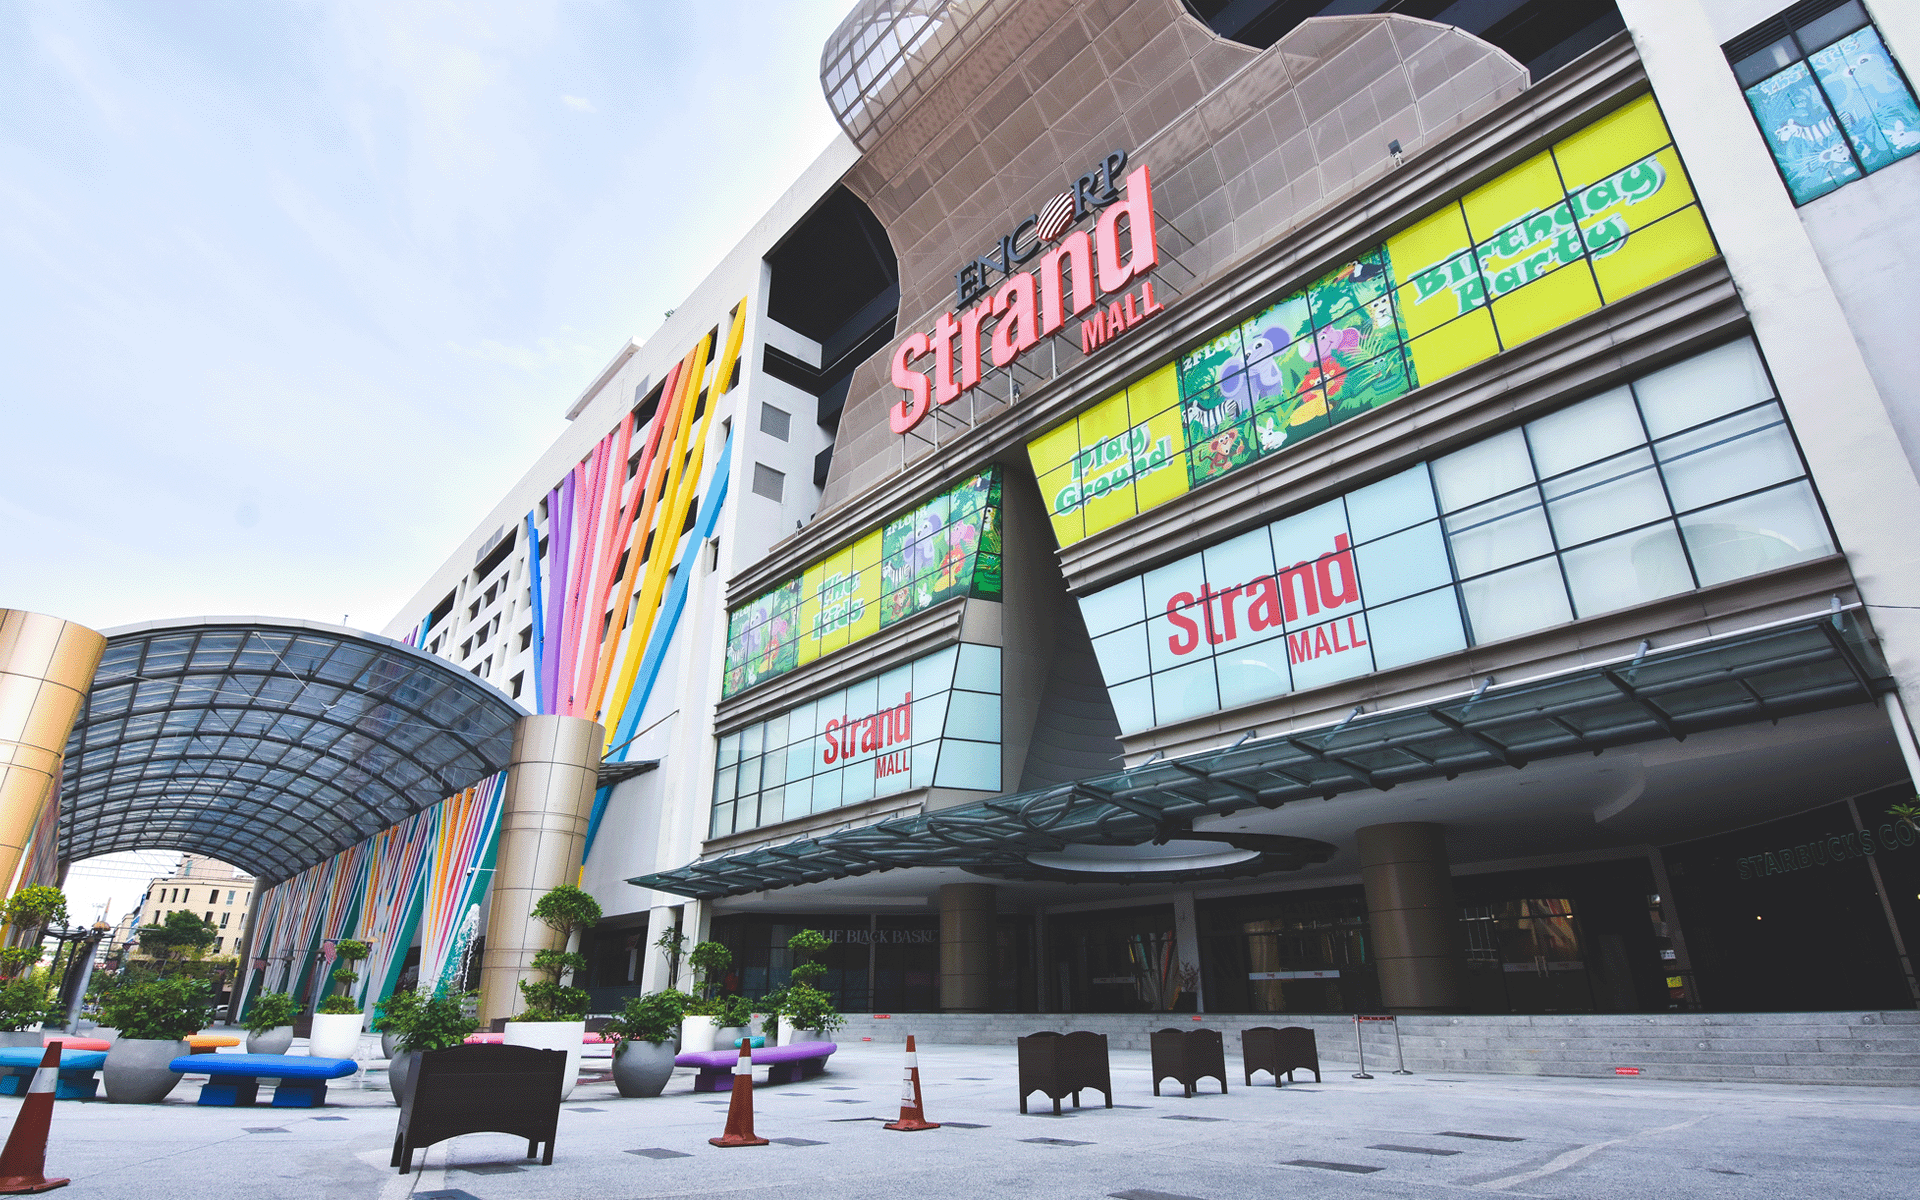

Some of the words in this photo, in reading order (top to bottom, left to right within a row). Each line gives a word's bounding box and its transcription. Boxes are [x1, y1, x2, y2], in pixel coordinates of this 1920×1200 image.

[954, 149, 1127, 310] ENCORP
[1407, 154, 1667, 306] Birthday
[1451, 211, 1630, 317] Party
[889, 164, 1158, 435] Strand
[1081, 281, 1165, 357] MALL
[1054, 435, 1174, 517] Ground
[1070, 422, 1151, 482] Play
[811, 598, 866, 641] Kids
[817, 570, 861, 609] The
[1166, 533, 1359, 656] Strand
[1287, 617, 1367, 666] MALL
[823, 691, 912, 765] Strand
[875, 750, 911, 779] MALL
[1736, 829, 1877, 880] STARBUCKS
[846, 929, 889, 946] BLACK
[892, 929, 939, 944] BASKE
